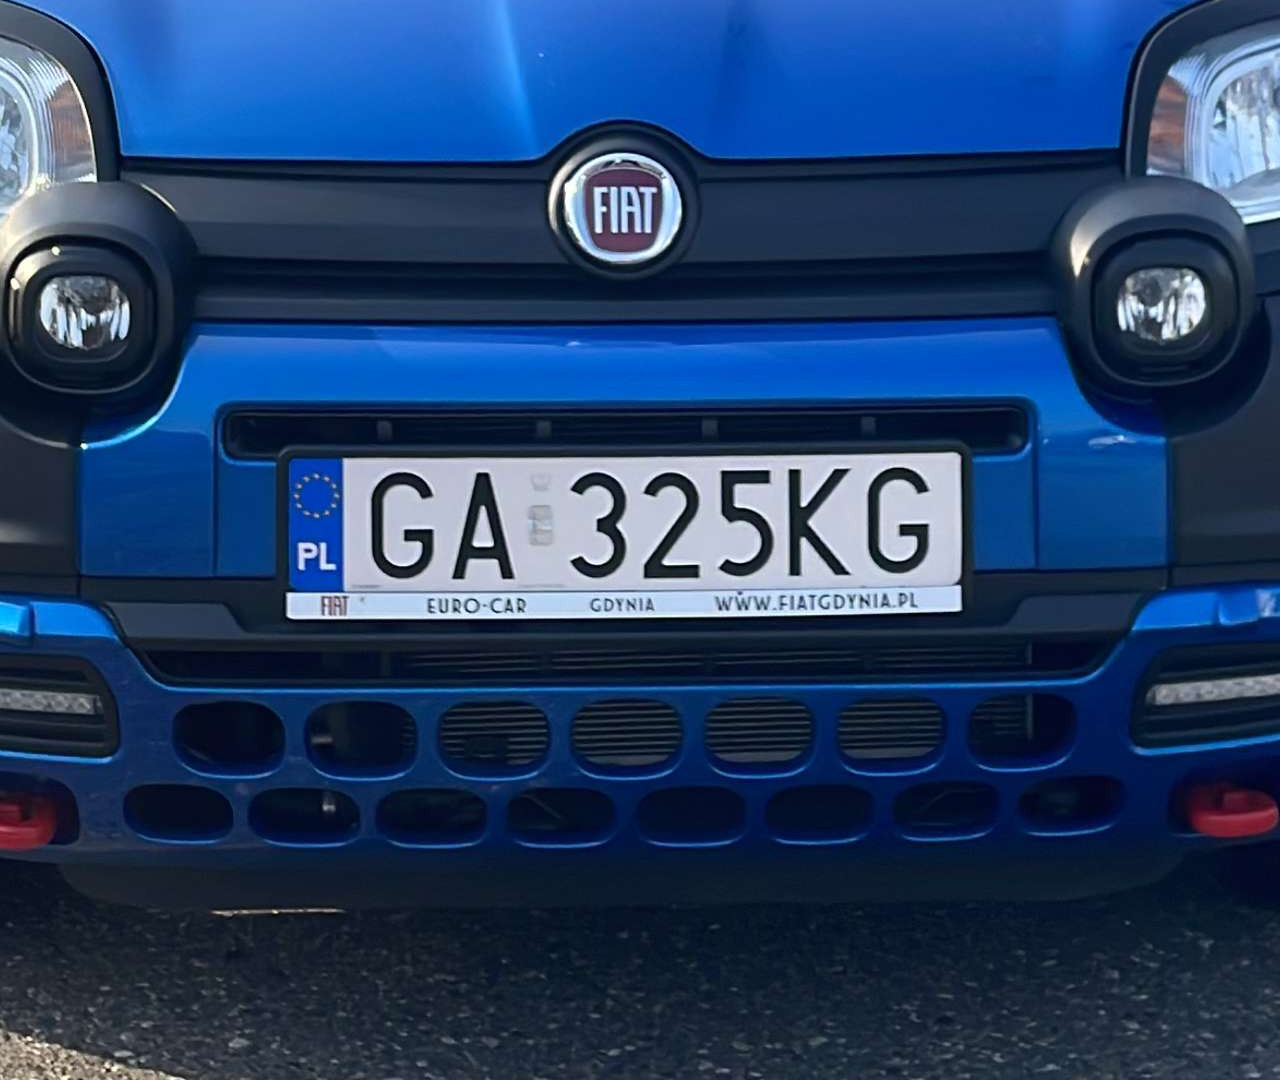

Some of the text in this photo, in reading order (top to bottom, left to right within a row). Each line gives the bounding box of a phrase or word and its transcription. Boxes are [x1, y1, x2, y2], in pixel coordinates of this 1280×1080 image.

[593, 186, 658, 234] FIAT
[371, 467, 930, 579] GA 325KG
[297, 542, 337, 571] PL
[321, 591, 919, 616] FIAT EURO-CAR GDYNIA WWW.FIATGDYNIA.PL
